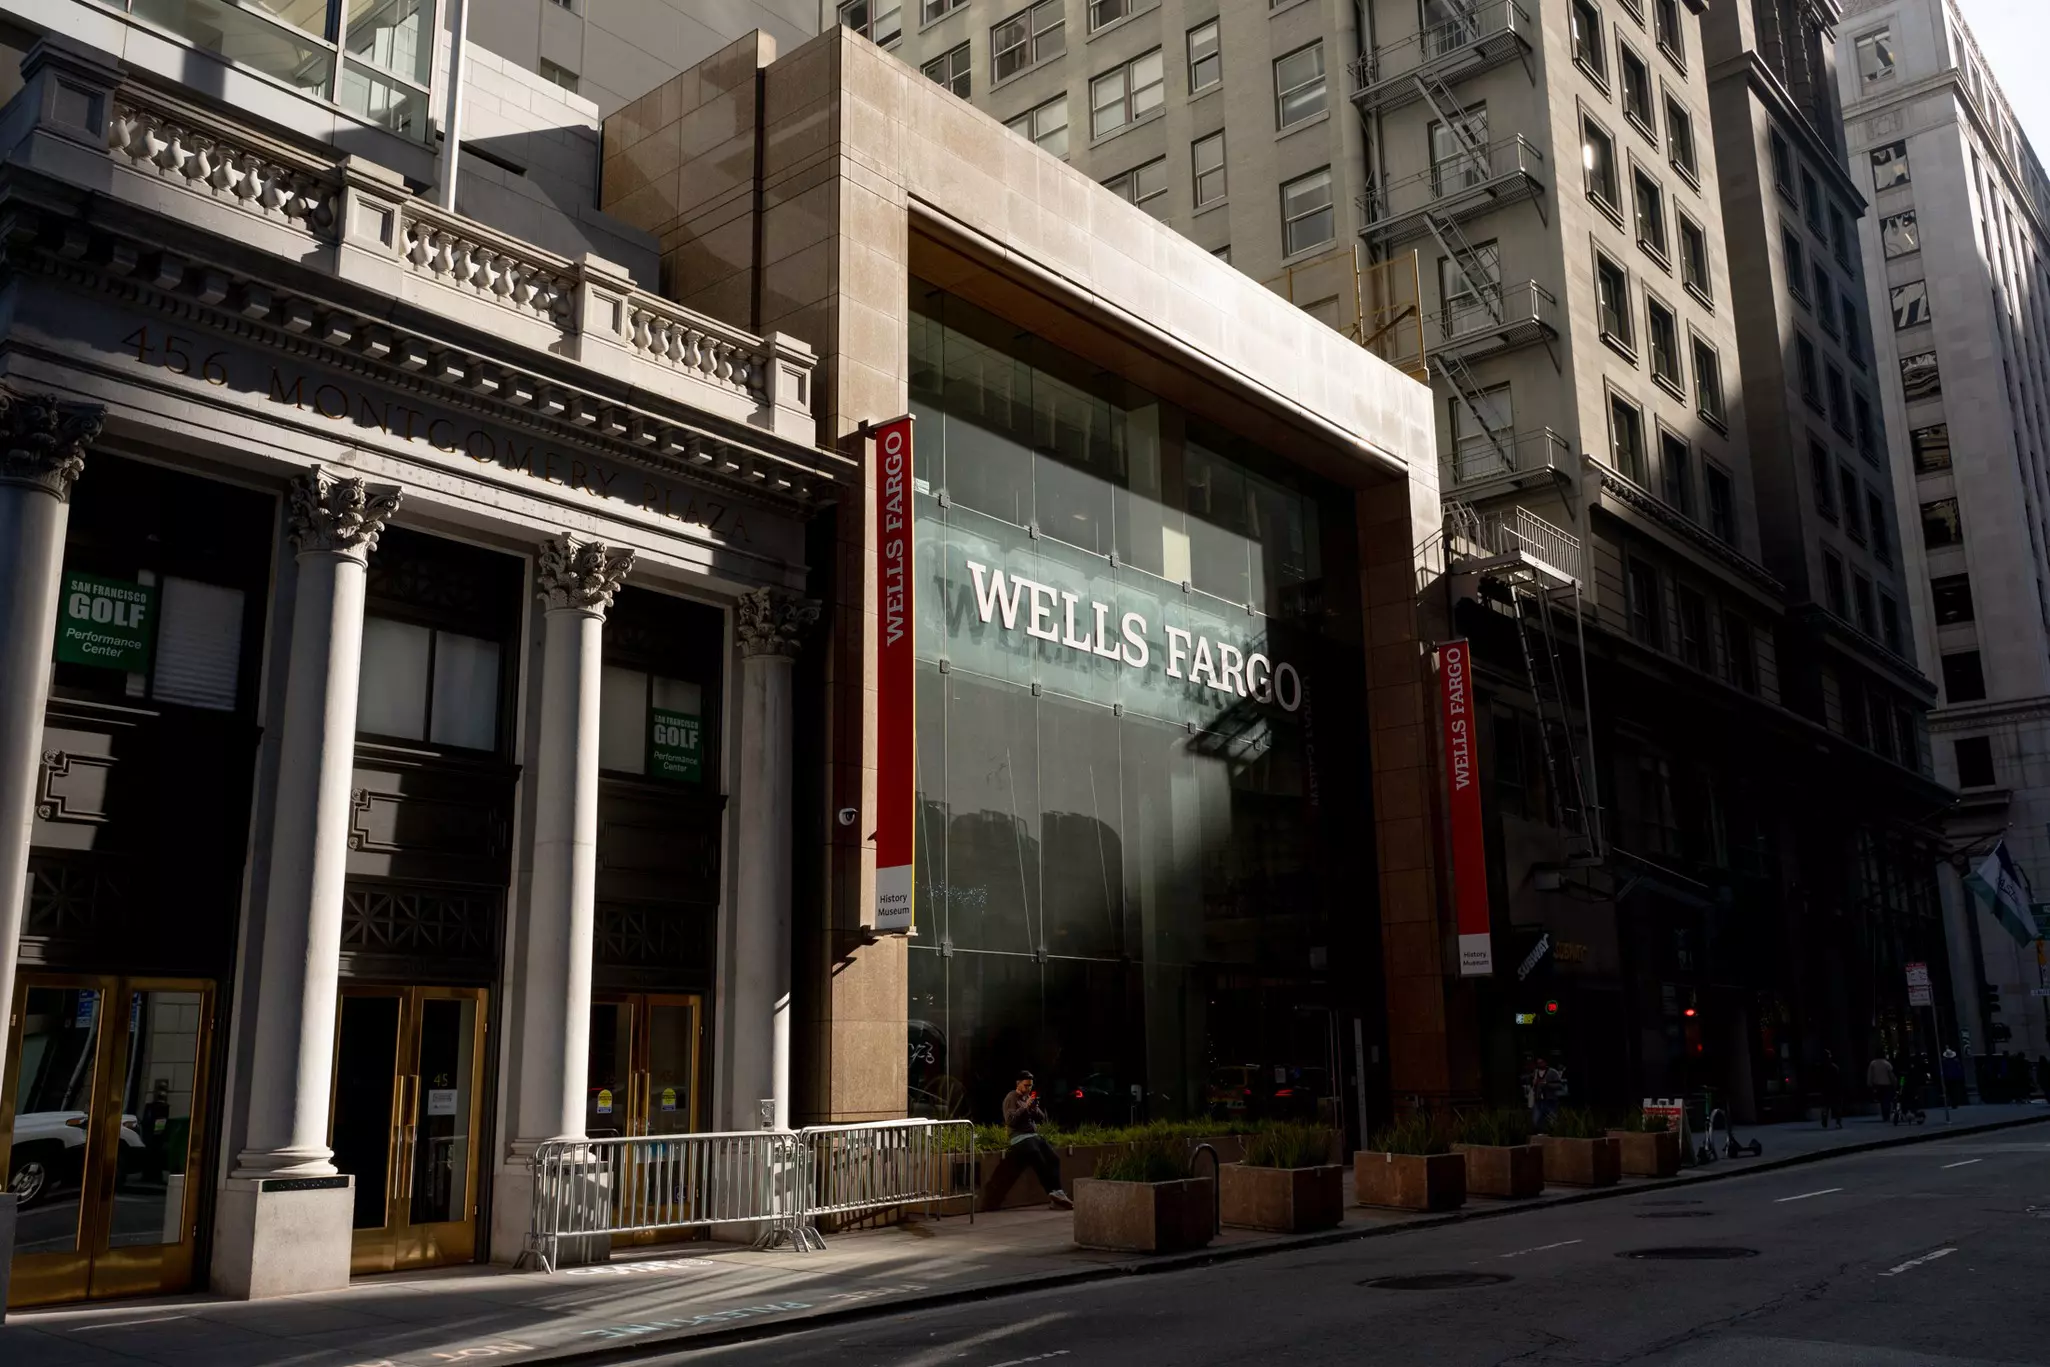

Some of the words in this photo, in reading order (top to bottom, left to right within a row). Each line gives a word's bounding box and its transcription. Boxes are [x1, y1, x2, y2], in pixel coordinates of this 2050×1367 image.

[121, 325, 229, 386] 456
[268, 365, 618, 499] MONTGOMERY
[641, 482, 752, 543] PLAZA
[885, 431, 903, 533] FARGO
[71, 579, 91, 593] SAN
[92, 584, 147, 603] FRANCISCO
[886, 538, 904, 647] WELLS
[68, 592, 146, 629] GOLF
[66, 627, 142, 650] Performance
[966, 560, 1150, 668] WELLS
[1164, 624, 1301, 712] FARGO
[81, 641, 124, 658] Center
[1446, 647, 1465, 715] FARGO
[666, 717, 699, 729] FRANCISCO
[653, 723, 699, 750] GOLF
[653, 750, 698, 765] Performance
[663, 761, 688, 772] Center
[1451, 719, 1470, 790] WELLS
[878, 907, 910, 916] Museum
[880, 894, 907, 904] History
[1463, 951, 1487, 959] History
[1517, 932, 1550, 981] SUBWAY
